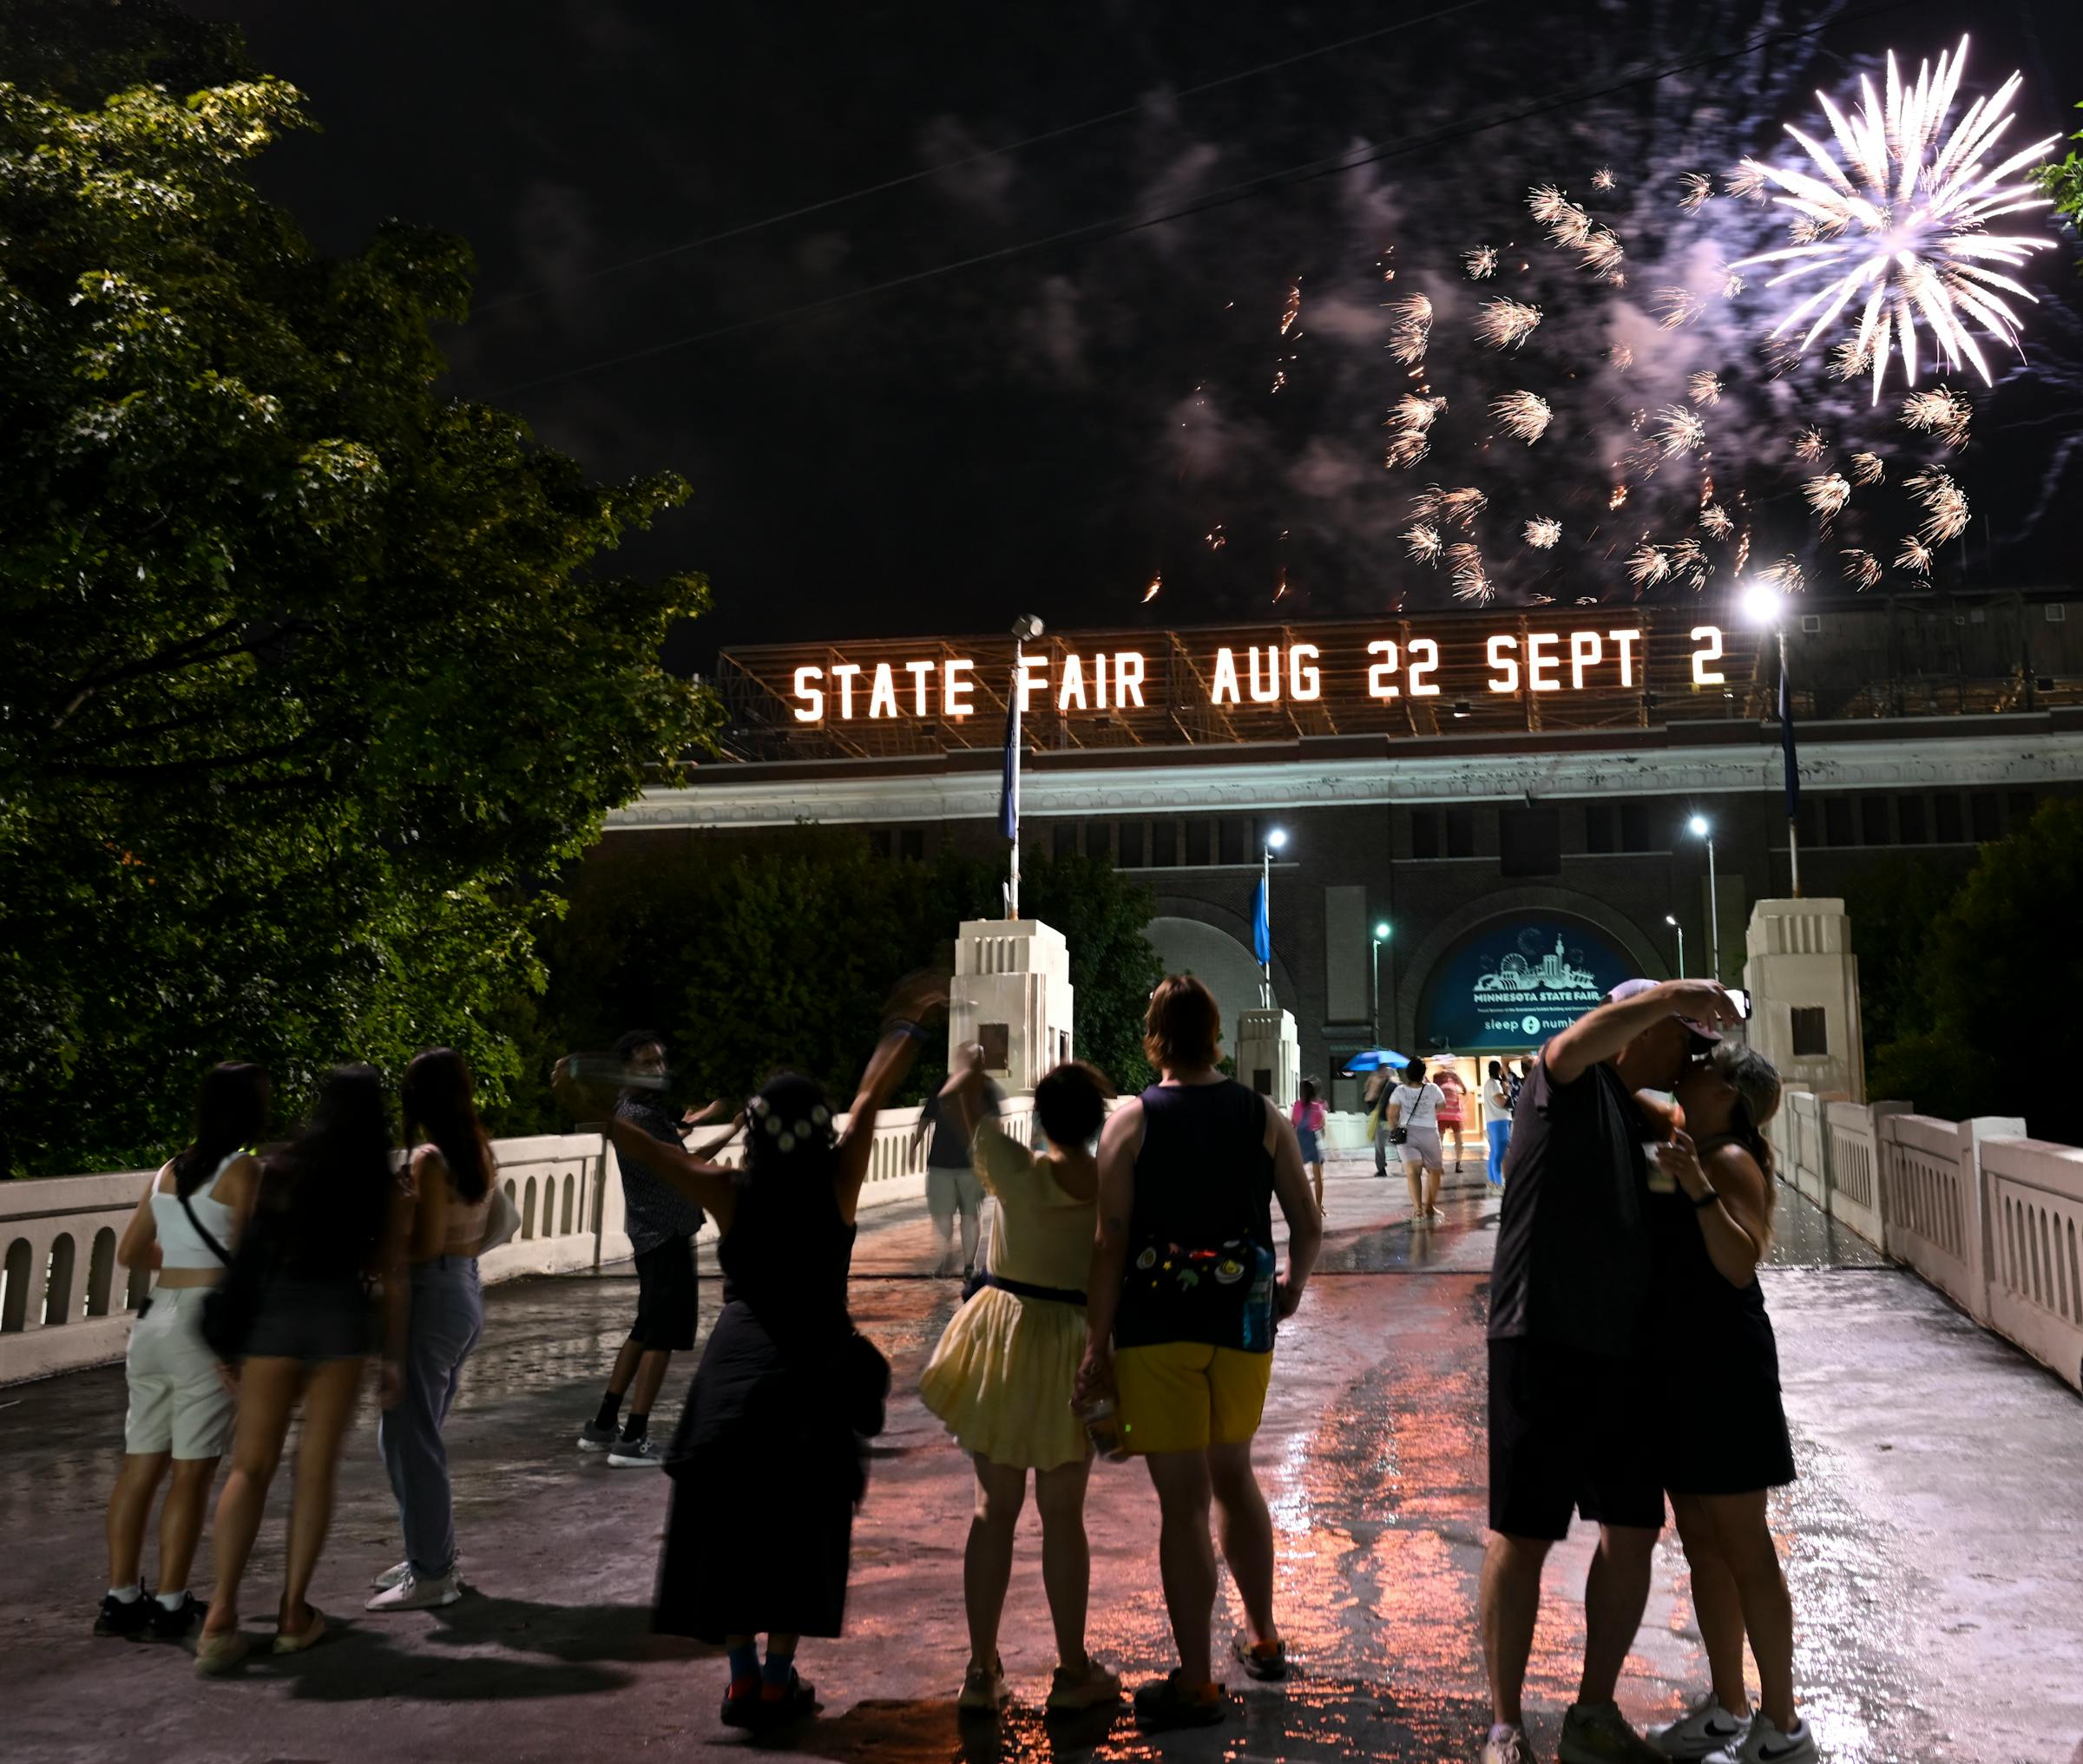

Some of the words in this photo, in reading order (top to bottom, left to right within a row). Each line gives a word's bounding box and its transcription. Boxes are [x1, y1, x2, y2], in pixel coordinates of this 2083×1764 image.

[793, 659, 974, 722] STATE
[1018, 652, 1145, 712] FAIR
[1211, 644, 1320, 705] AUG
[1368, 639, 1441, 698] 22
[1487, 629, 1640, 693] SEPT
[1690, 626, 1725, 685] 2
[1473, 992, 1539, 1003] MINNESOTA
[1539, 991, 1574, 1001] STATE
[1574, 990, 1600, 1001] FAIR
[1484, 1018, 1519, 1033] sleep
